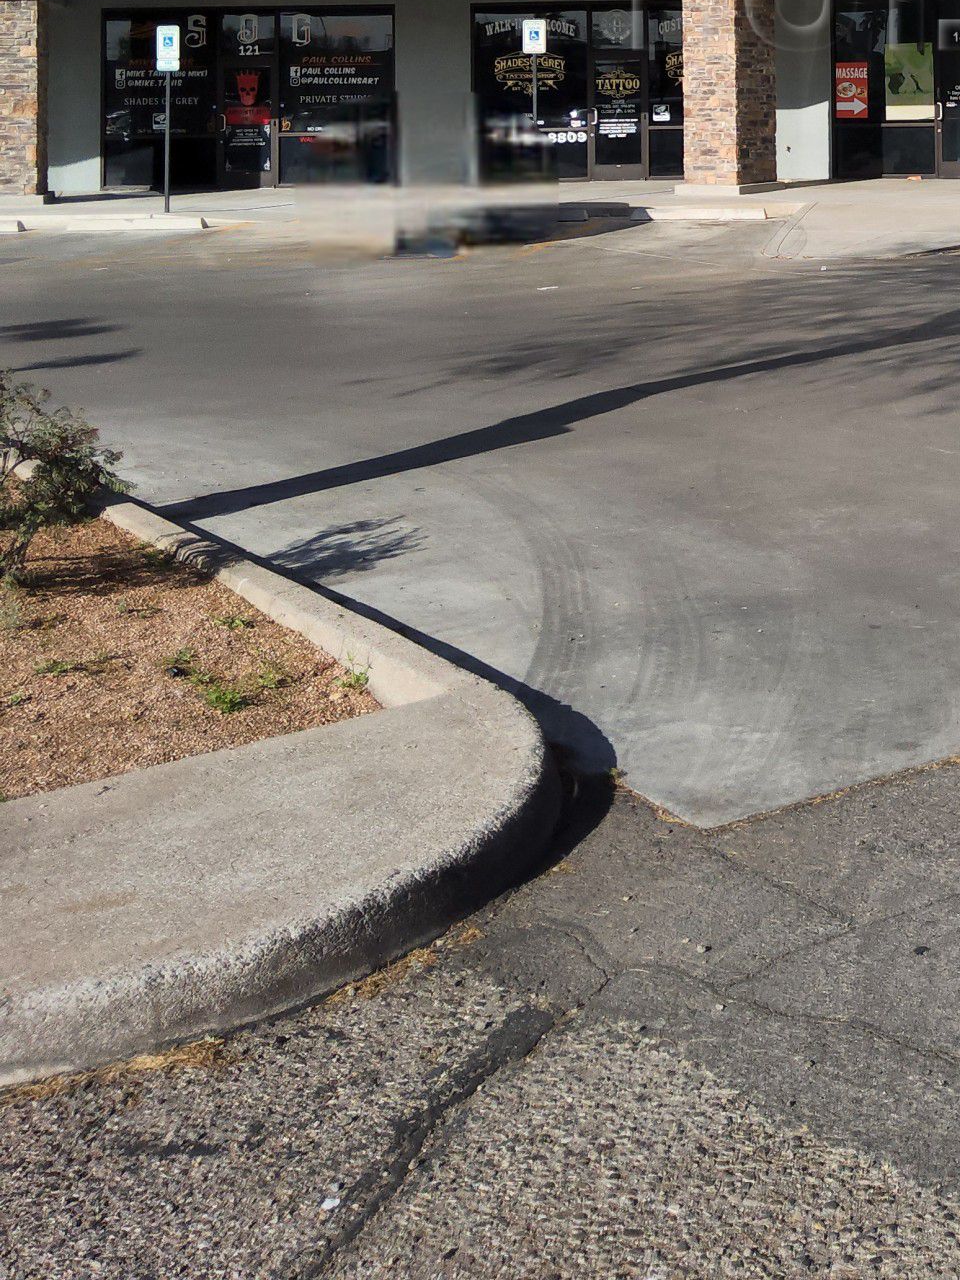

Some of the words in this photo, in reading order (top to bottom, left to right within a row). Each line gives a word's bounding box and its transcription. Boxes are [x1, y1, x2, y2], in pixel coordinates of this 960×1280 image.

[546, 19, 576, 37] LCOME
[658, 18, 682, 35] CUST
[238, 45, 260, 55] 121
[302, 56, 326, 64] PAUL
[331, 55, 372, 64] COLLINS
[126, 69, 145, 77] MIKE
[301, 67, 322, 75] PAUL
[324, 67, 356, 75] COLLINS
[835, 67, 868, 79] MASSAGE
[300, 77, 380, 85] @PAULCOLLINSART
[595, 79, 640, 91] TATTOO
[124, 97, 159, 106] SHADES
[175, 97, 199, 105] GREY
[299, 95, 337, 103] PRIVATE
